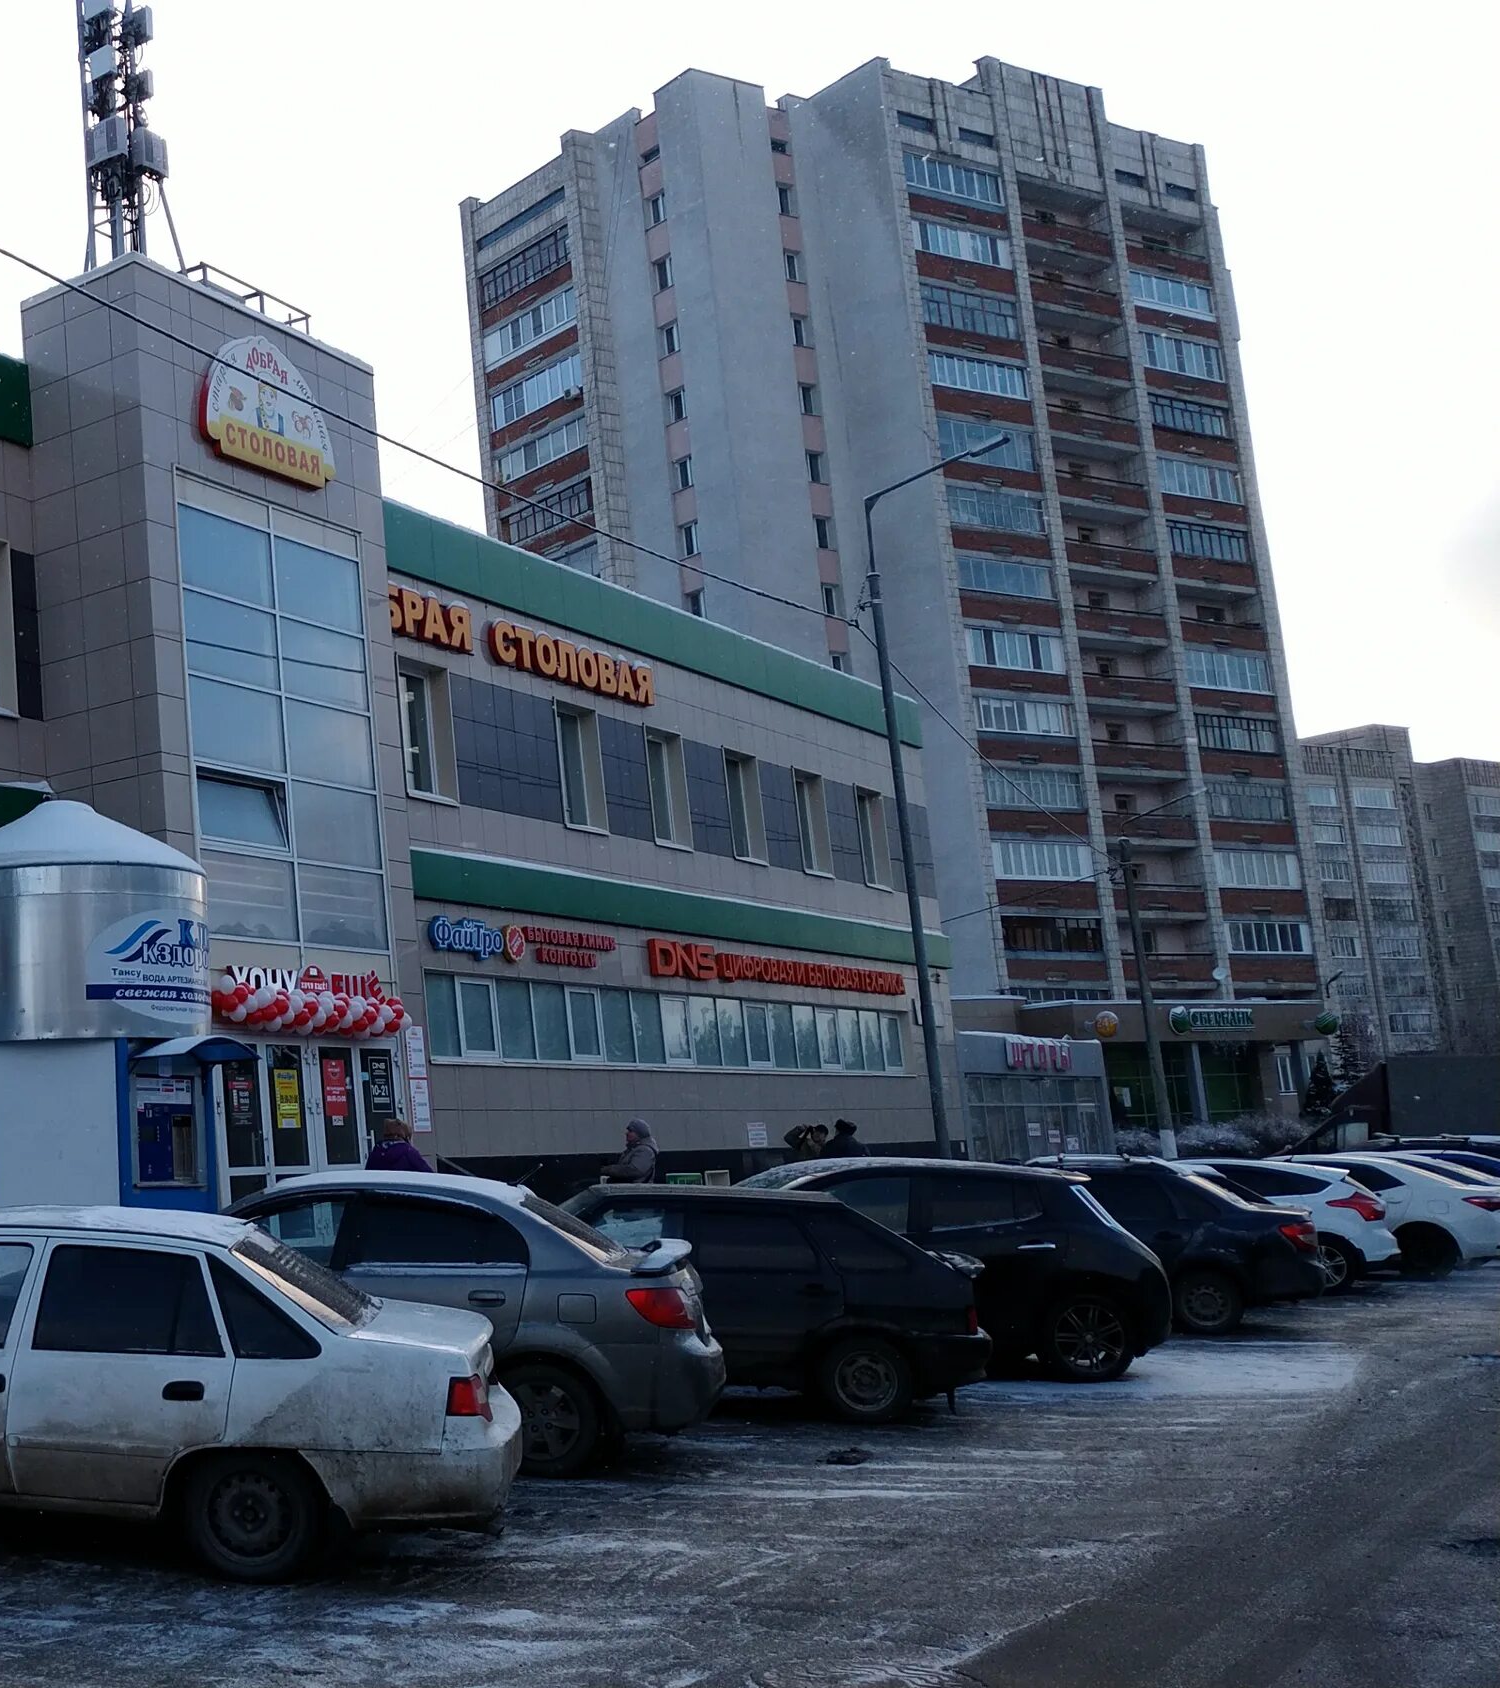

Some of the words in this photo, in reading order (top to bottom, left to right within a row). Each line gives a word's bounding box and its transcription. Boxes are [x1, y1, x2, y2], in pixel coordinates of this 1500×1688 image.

[245, 346, 289, 386] ДОБРАЯ
[225, 422, 320, 477] СТОЛОВАЯ
[492, 616, 655, 706] СТОЛОВАЯ
[526, 926, 580, 946] БЫТОВАЯ
[581, 933, 616, 951] ХИМИЯ
[540, 946, 597, 968] КОЛГОТКИ
[652, 938, 719, 980] DNS
[142, 974, 166, 983] ВОДА
[722, 953, 797, 984] ЦИФРОВАЯ
[797, 964, 807, 984] И
[808, 966, 861, 989] БЫТОВАЯ
[861, 971, 906, 994] ТЕХНИКА
[115, 987, 178, 999] свежая
[1190, 1009, 1254, 1027] СБЕРБАНК
[1007, 1036, 1072, 1073] ШТОРЫ
[371, 1084, 389, 1097] 10-21
